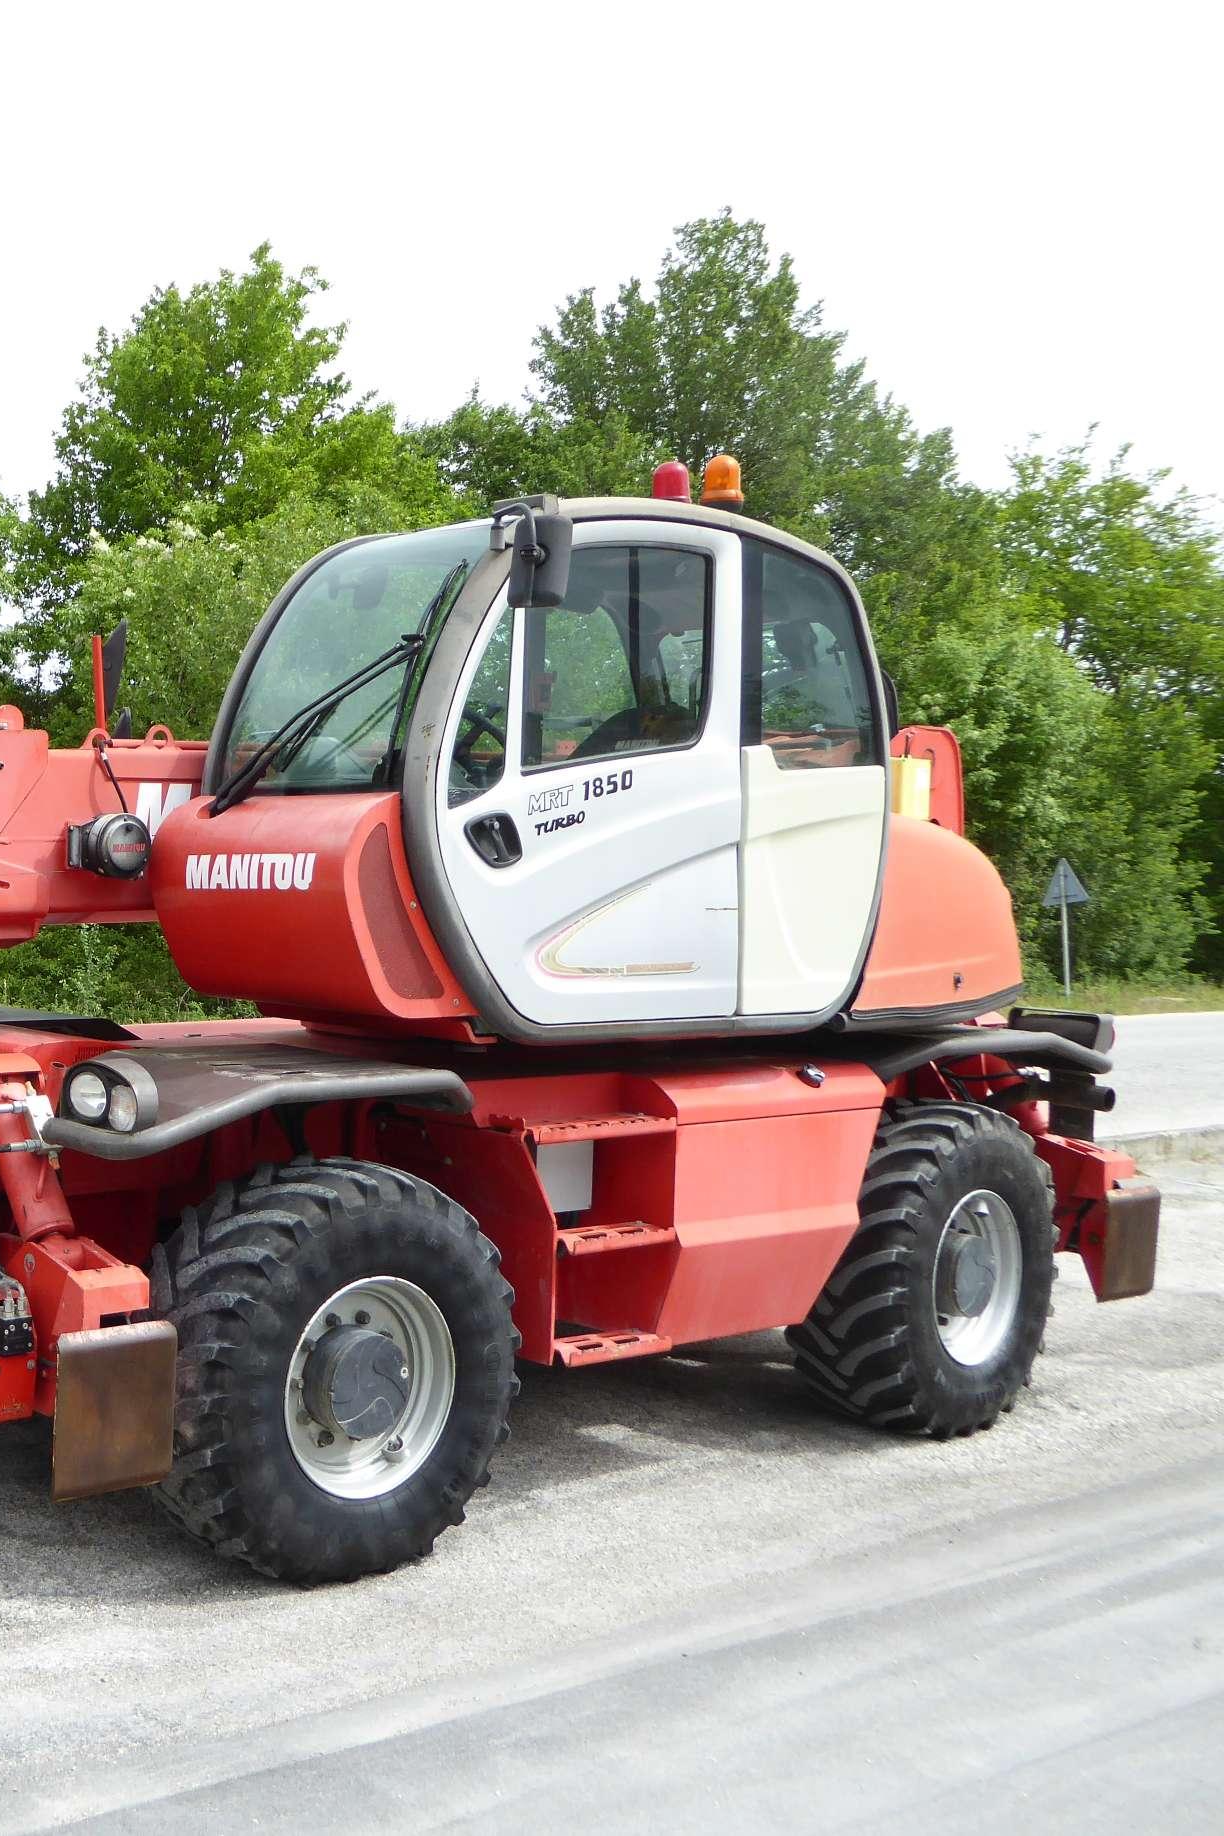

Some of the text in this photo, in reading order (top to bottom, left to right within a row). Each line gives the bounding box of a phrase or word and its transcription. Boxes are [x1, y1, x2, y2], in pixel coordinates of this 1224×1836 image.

[528, 769, 633, 815] MRT 1850
[534, 811, 585, 836] TURBO
[185, 853, 316, 890] MANITOU
